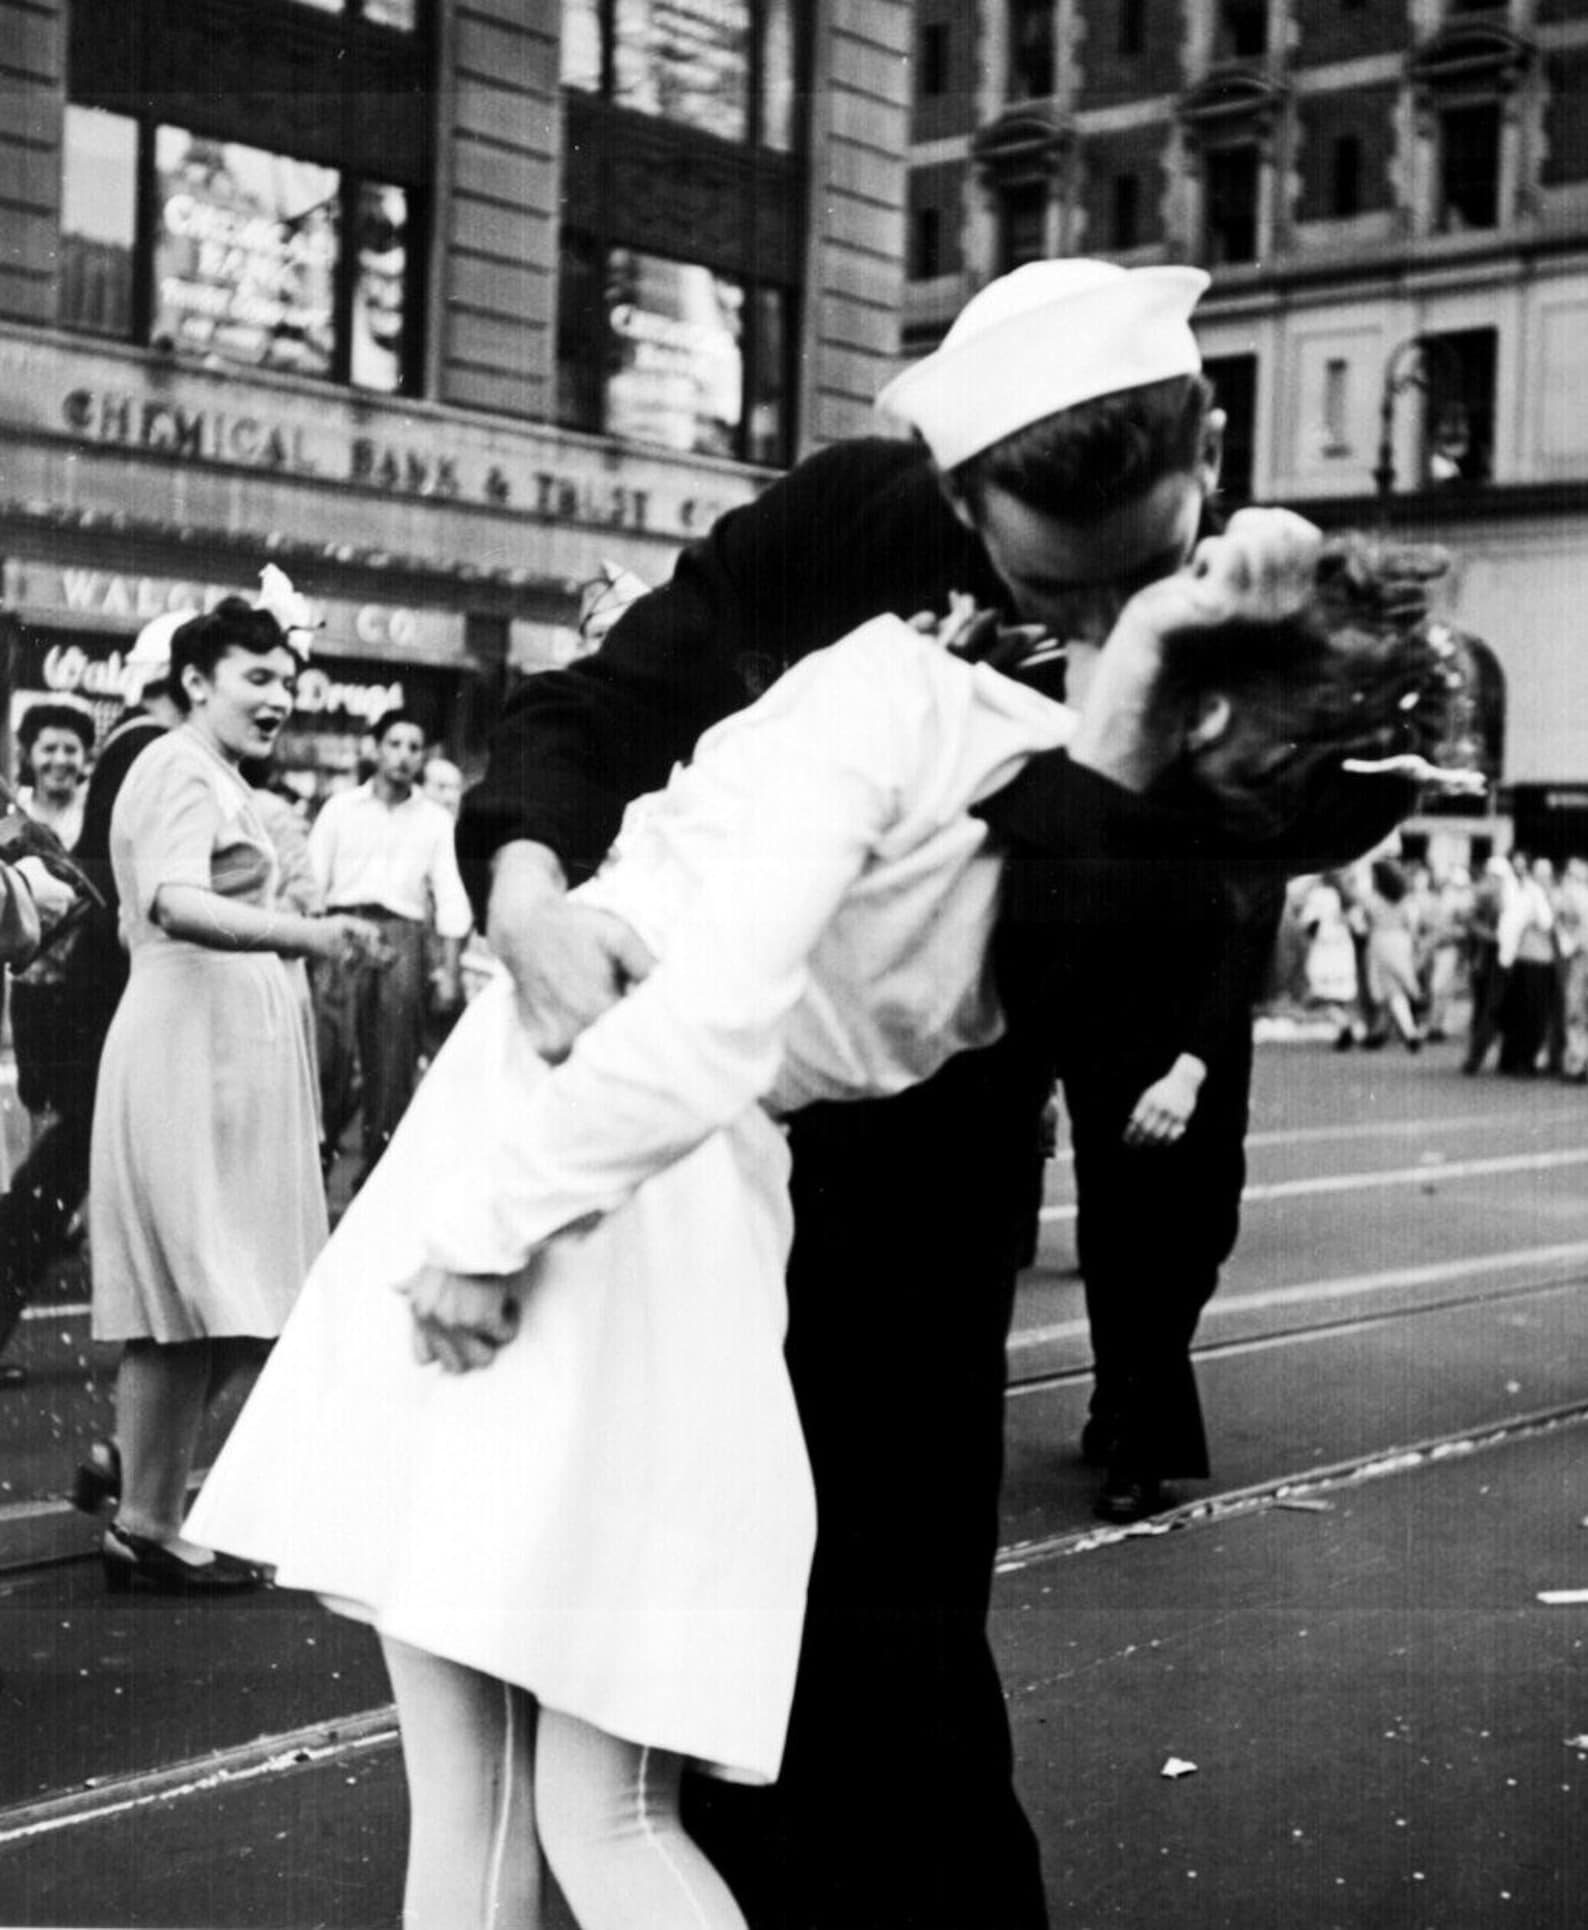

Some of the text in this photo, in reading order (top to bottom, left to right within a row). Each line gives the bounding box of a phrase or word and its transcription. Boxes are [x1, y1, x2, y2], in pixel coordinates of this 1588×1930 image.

[61, 387, 317, 472] CHEMICAL
[352, 437, 459, 500] BANK
[533, 472, 649, 532] TRUST
[356, 604, 416, 647] CO
